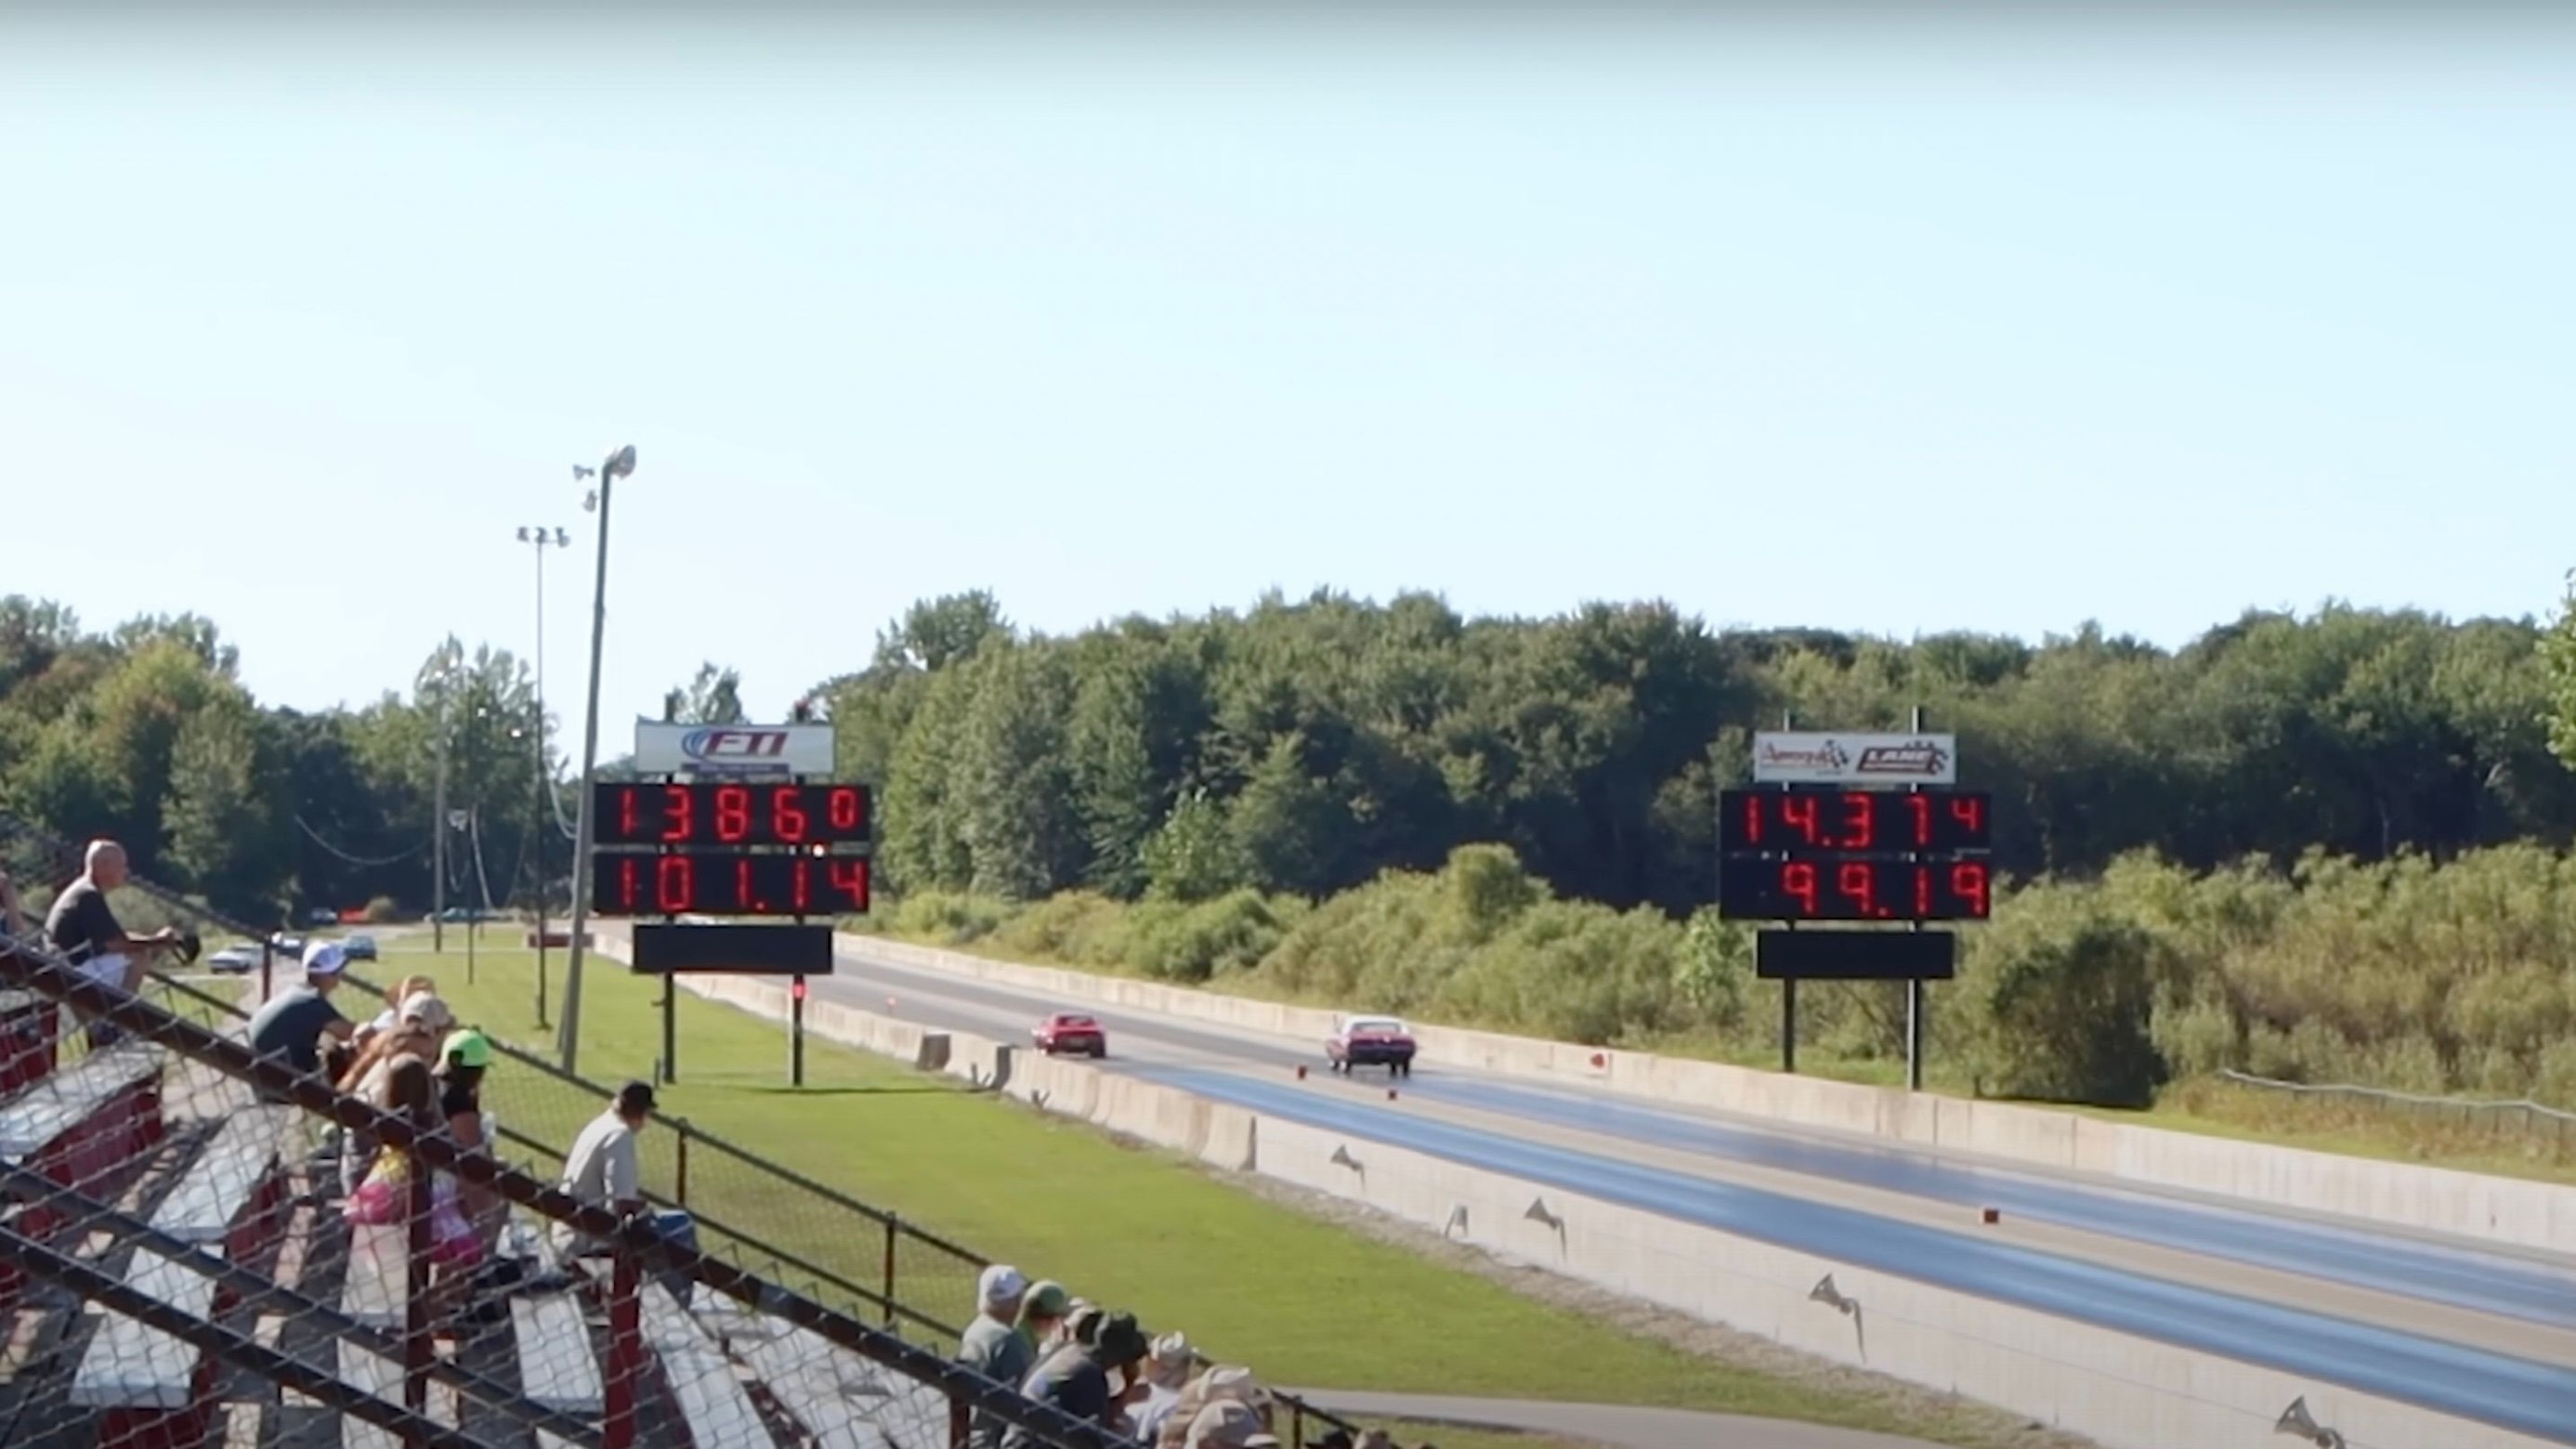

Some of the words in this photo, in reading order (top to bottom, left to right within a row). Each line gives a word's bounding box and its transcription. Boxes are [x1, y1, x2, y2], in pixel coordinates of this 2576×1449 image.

[1746, 792, 1980, 848] 14.374
[621, 855, 867, 912] 101.14
[1782, 863, 1987, 916] 99.19
